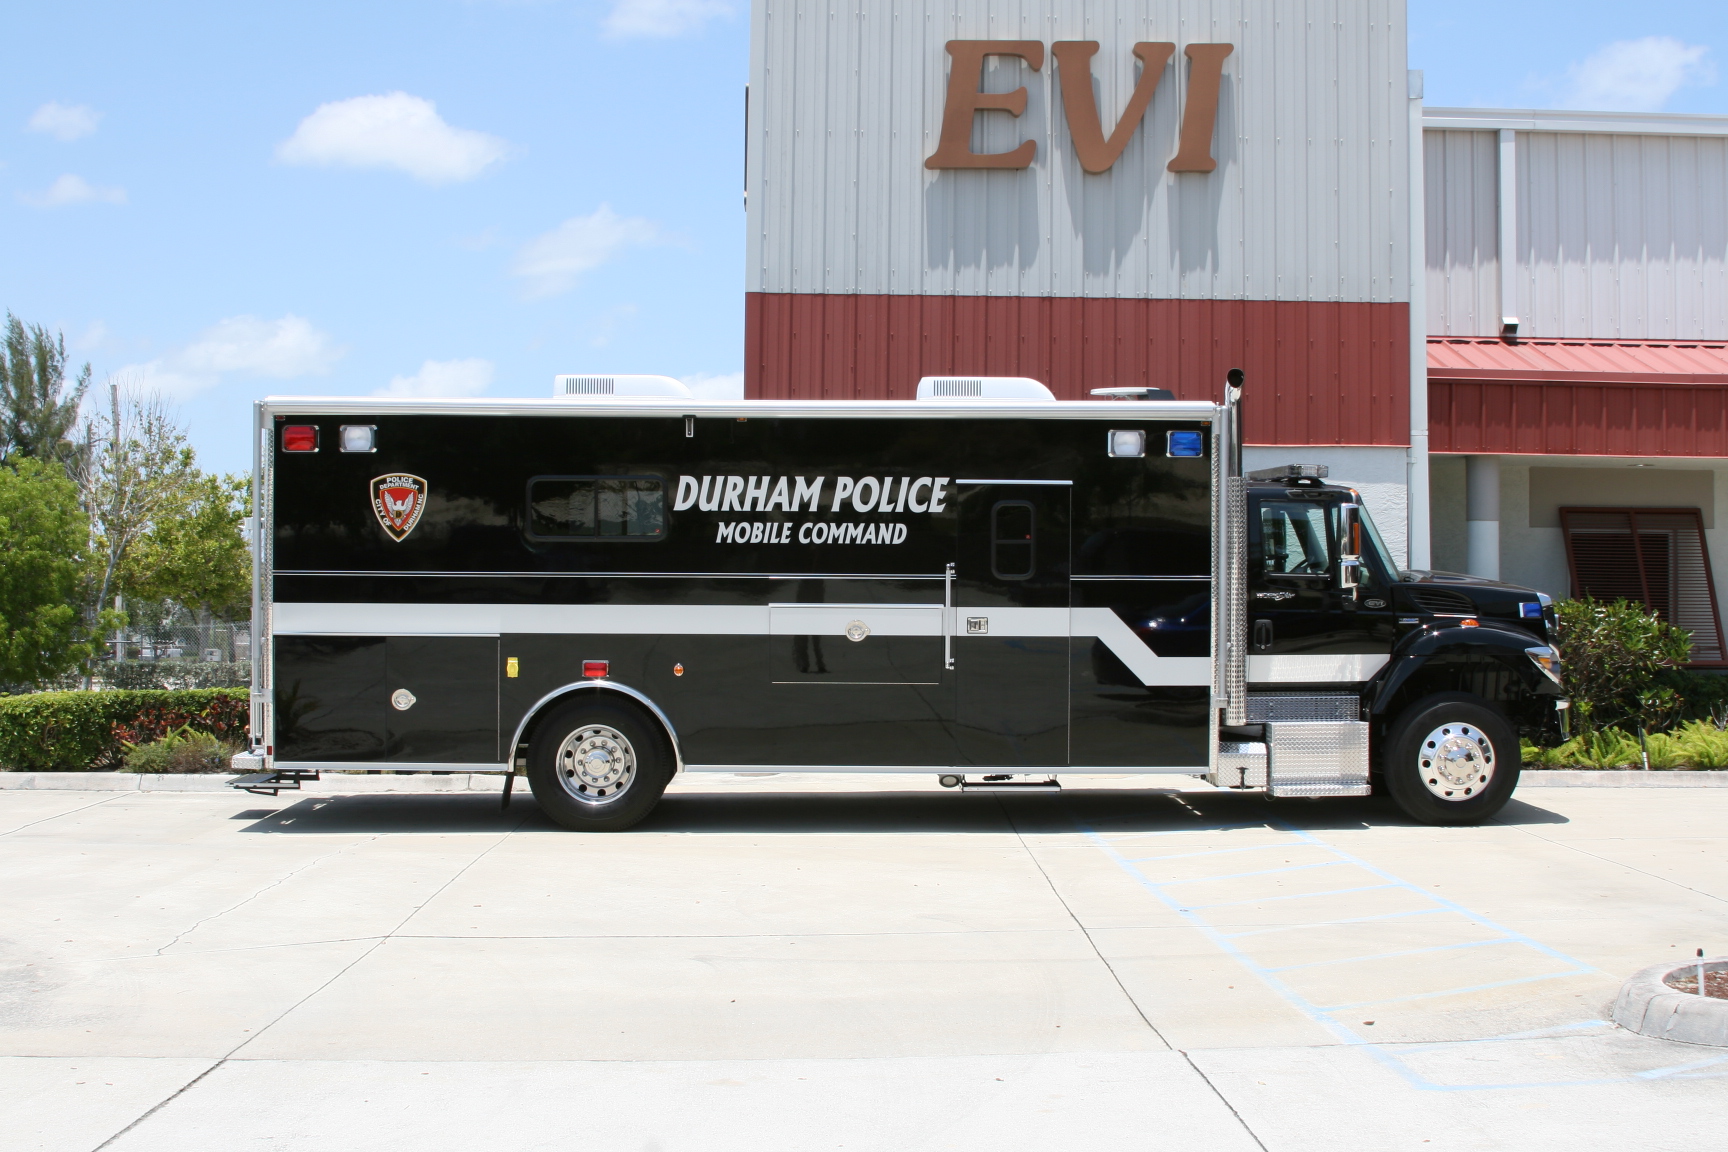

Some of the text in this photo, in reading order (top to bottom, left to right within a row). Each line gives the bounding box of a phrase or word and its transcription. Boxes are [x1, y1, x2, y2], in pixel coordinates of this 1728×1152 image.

[924, 40, 1235, 174] EVI
[673, 475, 950, 513] DURHAM POLICE
[375, 498, 386, 516] CITY
[382, 517, 392, 527] OF
[403, 506, 421, 531] DURHAM
[716, 521, 908, 545] MOBILE COMMAND
